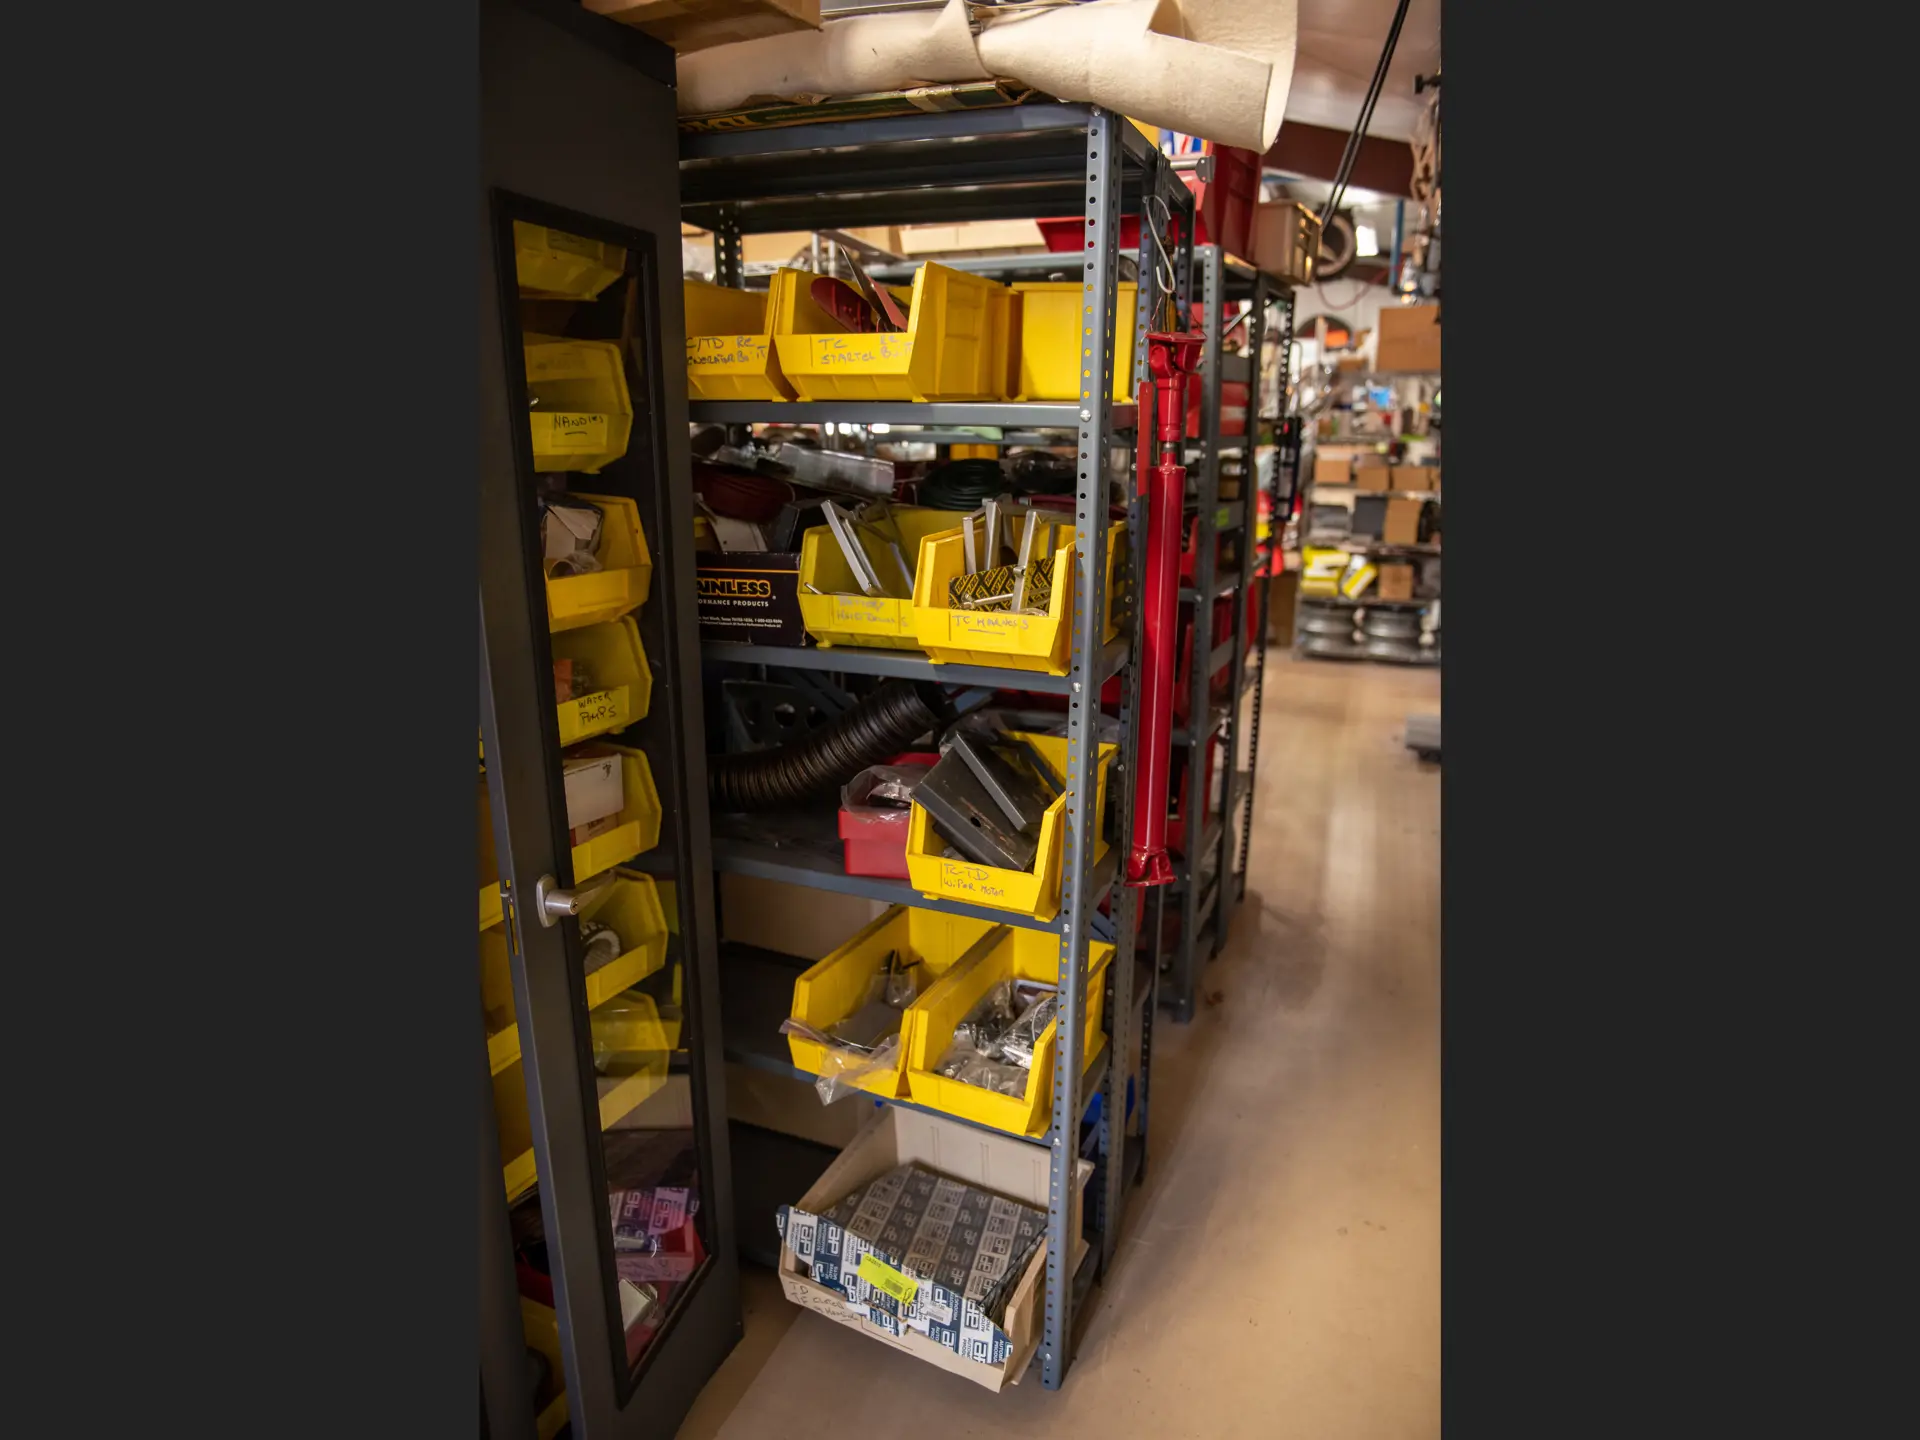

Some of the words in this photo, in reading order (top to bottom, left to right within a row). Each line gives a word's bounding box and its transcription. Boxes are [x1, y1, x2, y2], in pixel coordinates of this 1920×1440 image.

[818, 338, 848, 350] TC
[733, 599, 769, 607] PRODUCTS
[952, 615, 971, 627] TC
[579, 691, 612, 709] WATER
[579, 705, 617, 725] PUMPS
